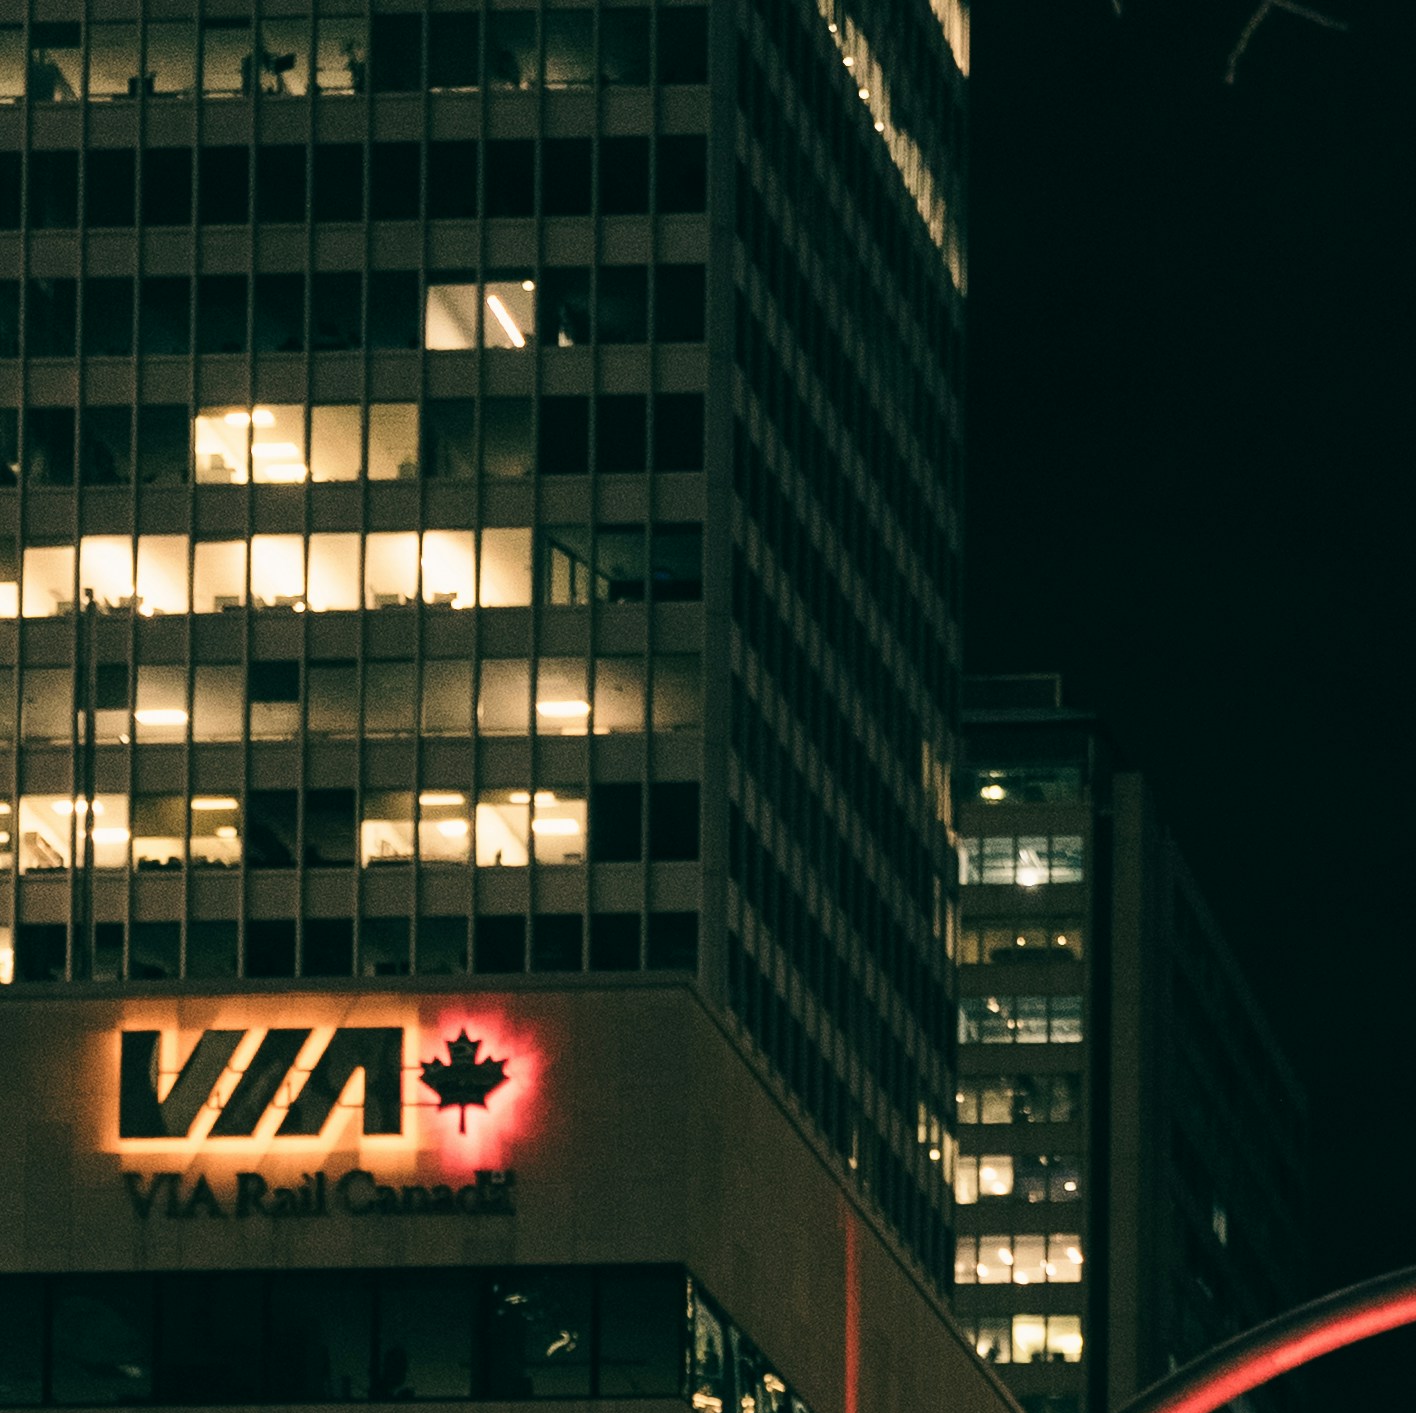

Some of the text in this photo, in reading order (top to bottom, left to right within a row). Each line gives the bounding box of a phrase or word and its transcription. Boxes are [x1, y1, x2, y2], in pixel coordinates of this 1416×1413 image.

[119, 1027, 404, 1138] VIA
[121, 1171, 230, 1218] VIA
[235, 1171, 328, 1217] Rail
